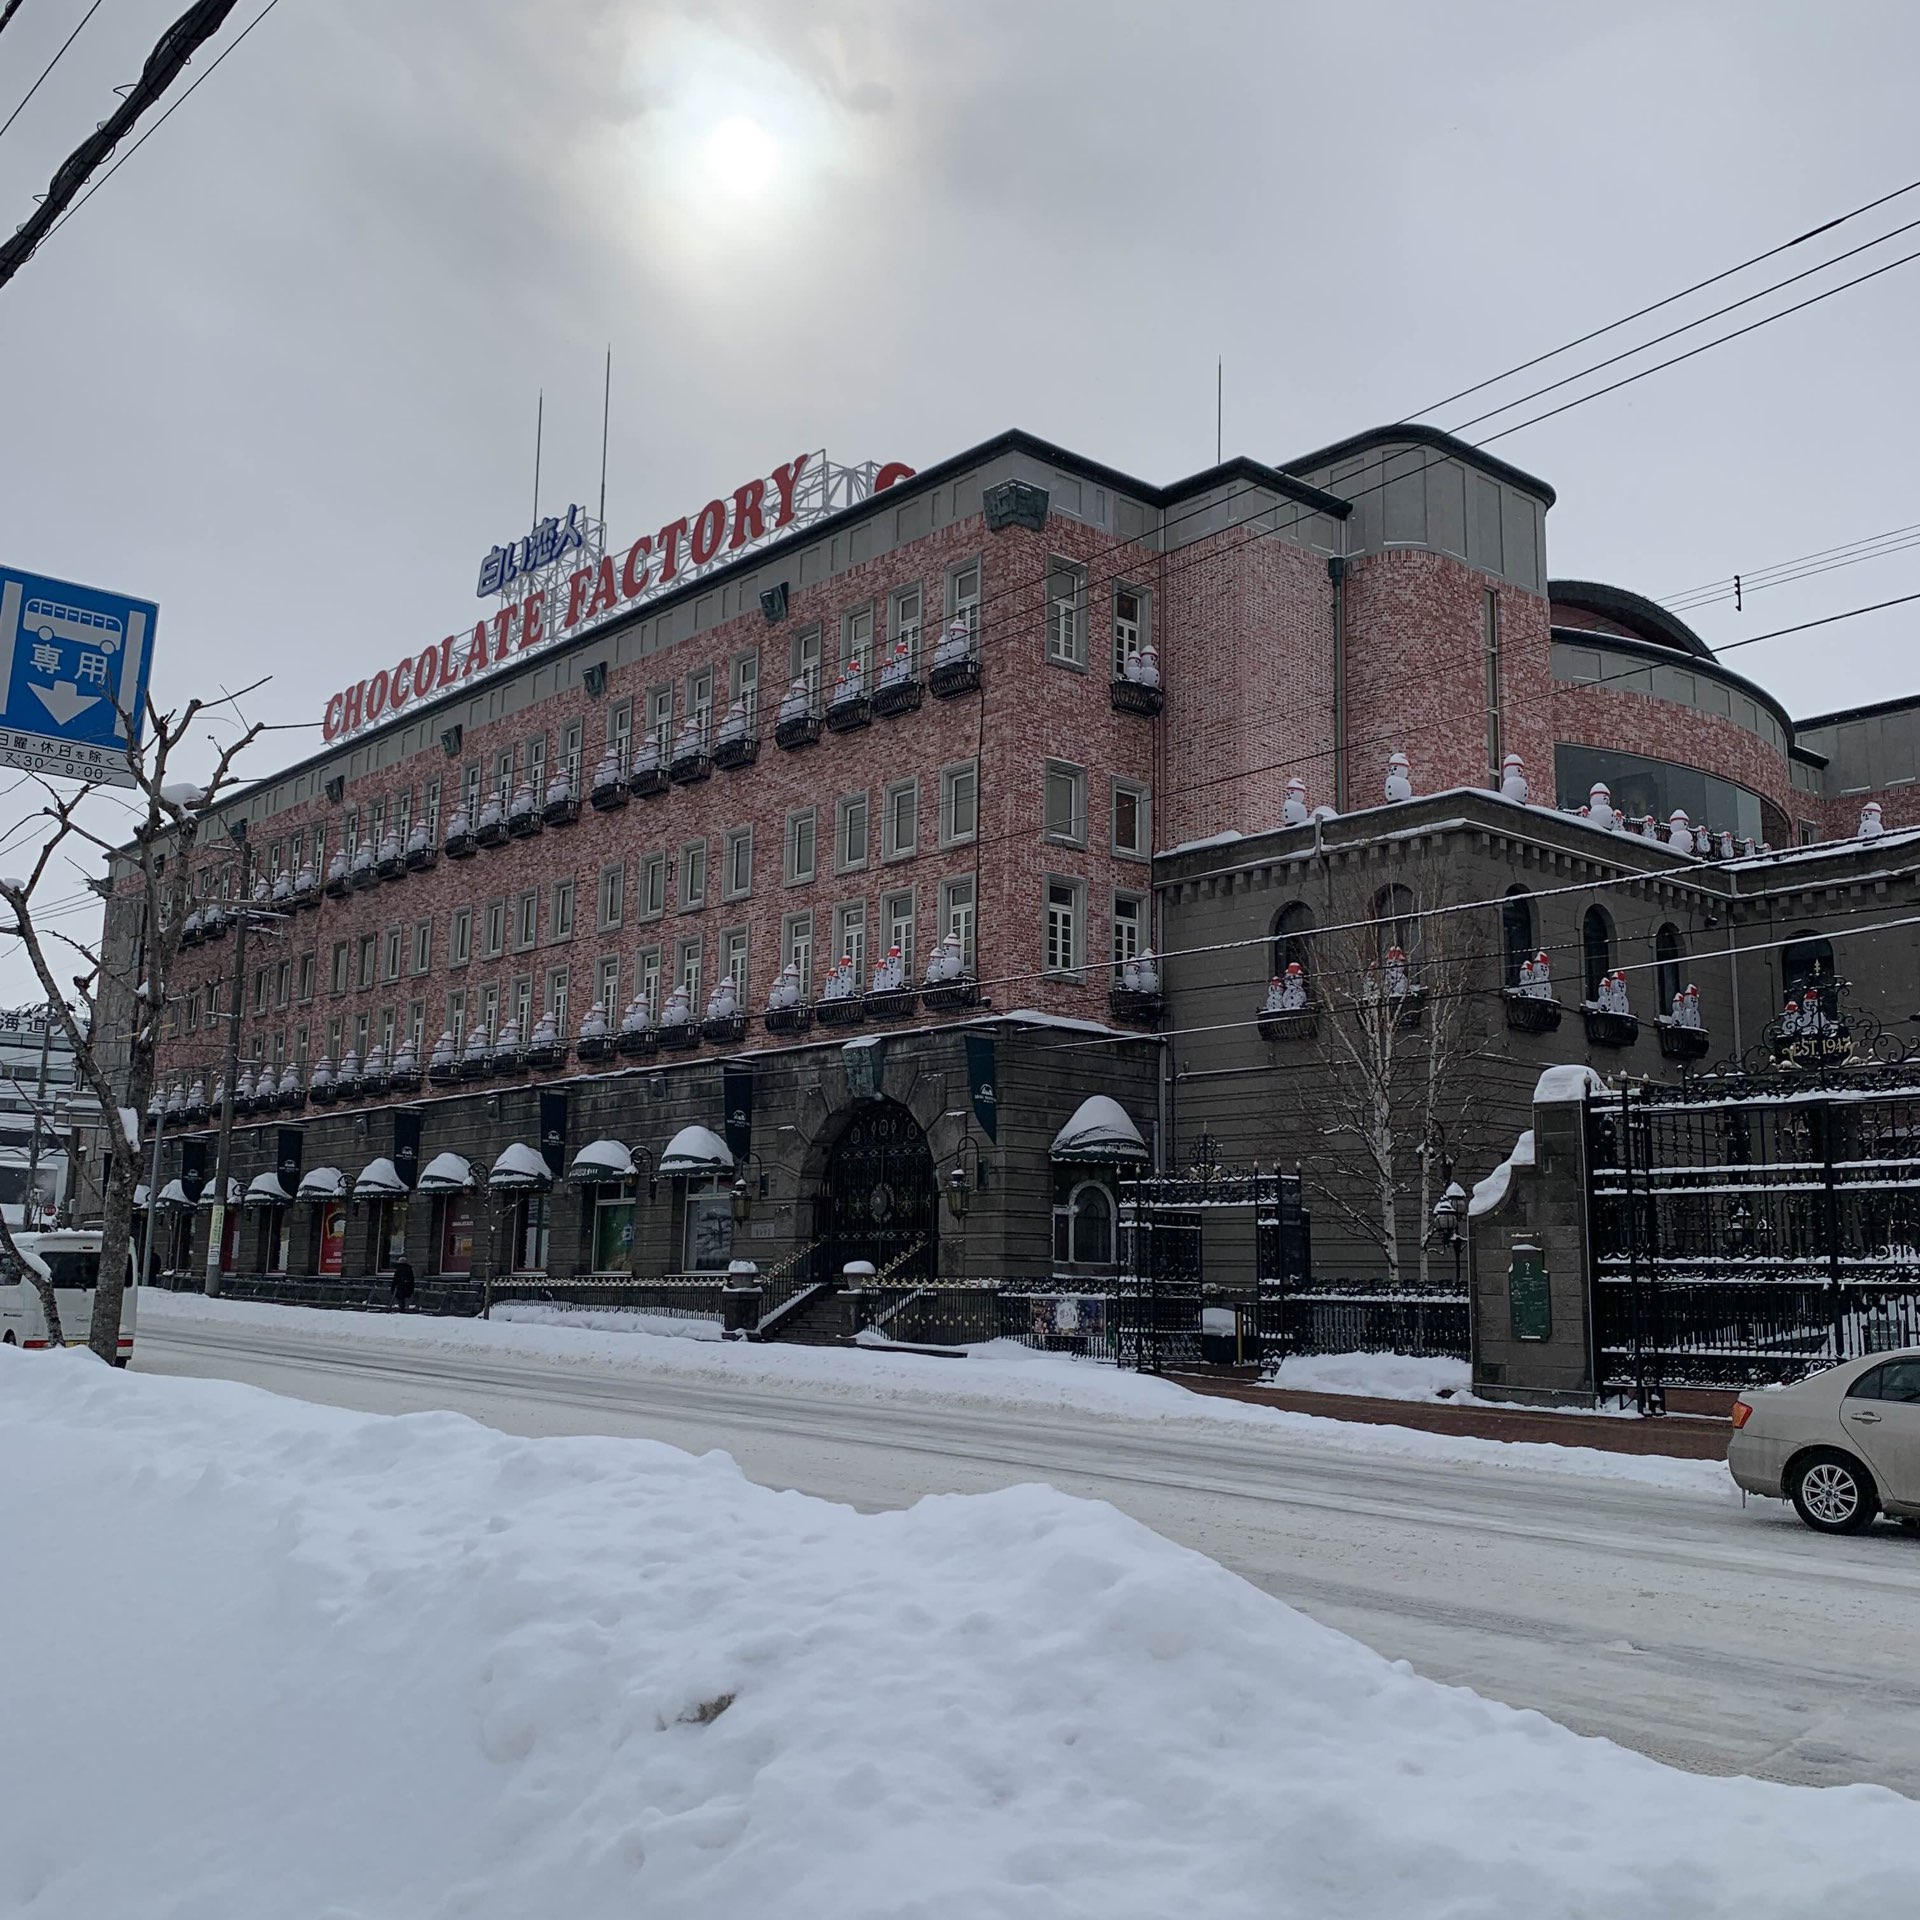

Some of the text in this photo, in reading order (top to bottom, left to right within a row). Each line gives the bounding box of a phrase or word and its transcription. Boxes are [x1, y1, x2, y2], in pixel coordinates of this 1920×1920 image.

[477, 503, 583, 597] 白い恋人
[322, 452, 811, 742] CHOCOLATE FACTORY
[30, 643, 108, 685] 専用
[1821, 1035, 1852, 1055] 1947
